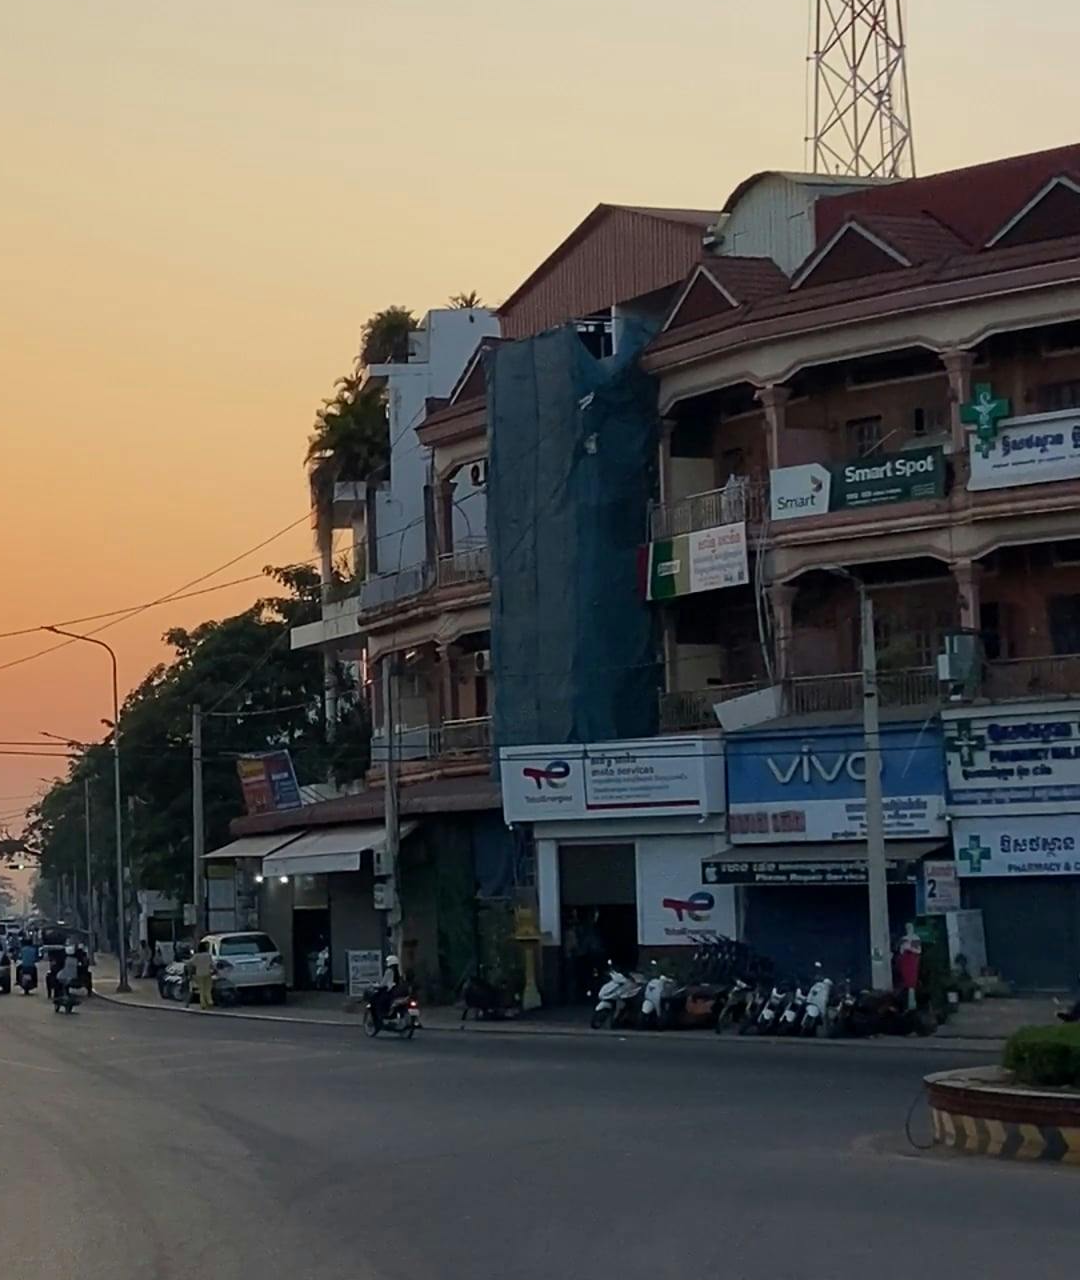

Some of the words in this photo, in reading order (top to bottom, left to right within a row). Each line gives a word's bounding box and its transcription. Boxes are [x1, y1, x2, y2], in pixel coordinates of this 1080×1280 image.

[844, 462, 893, 483] Smart
[895, 455, 935, 477] Spot
[777, 494, 817, 511] Smart
[766, 744, 883, 784] vivo
[1007, 862, 1061, 873] PHARMACY
